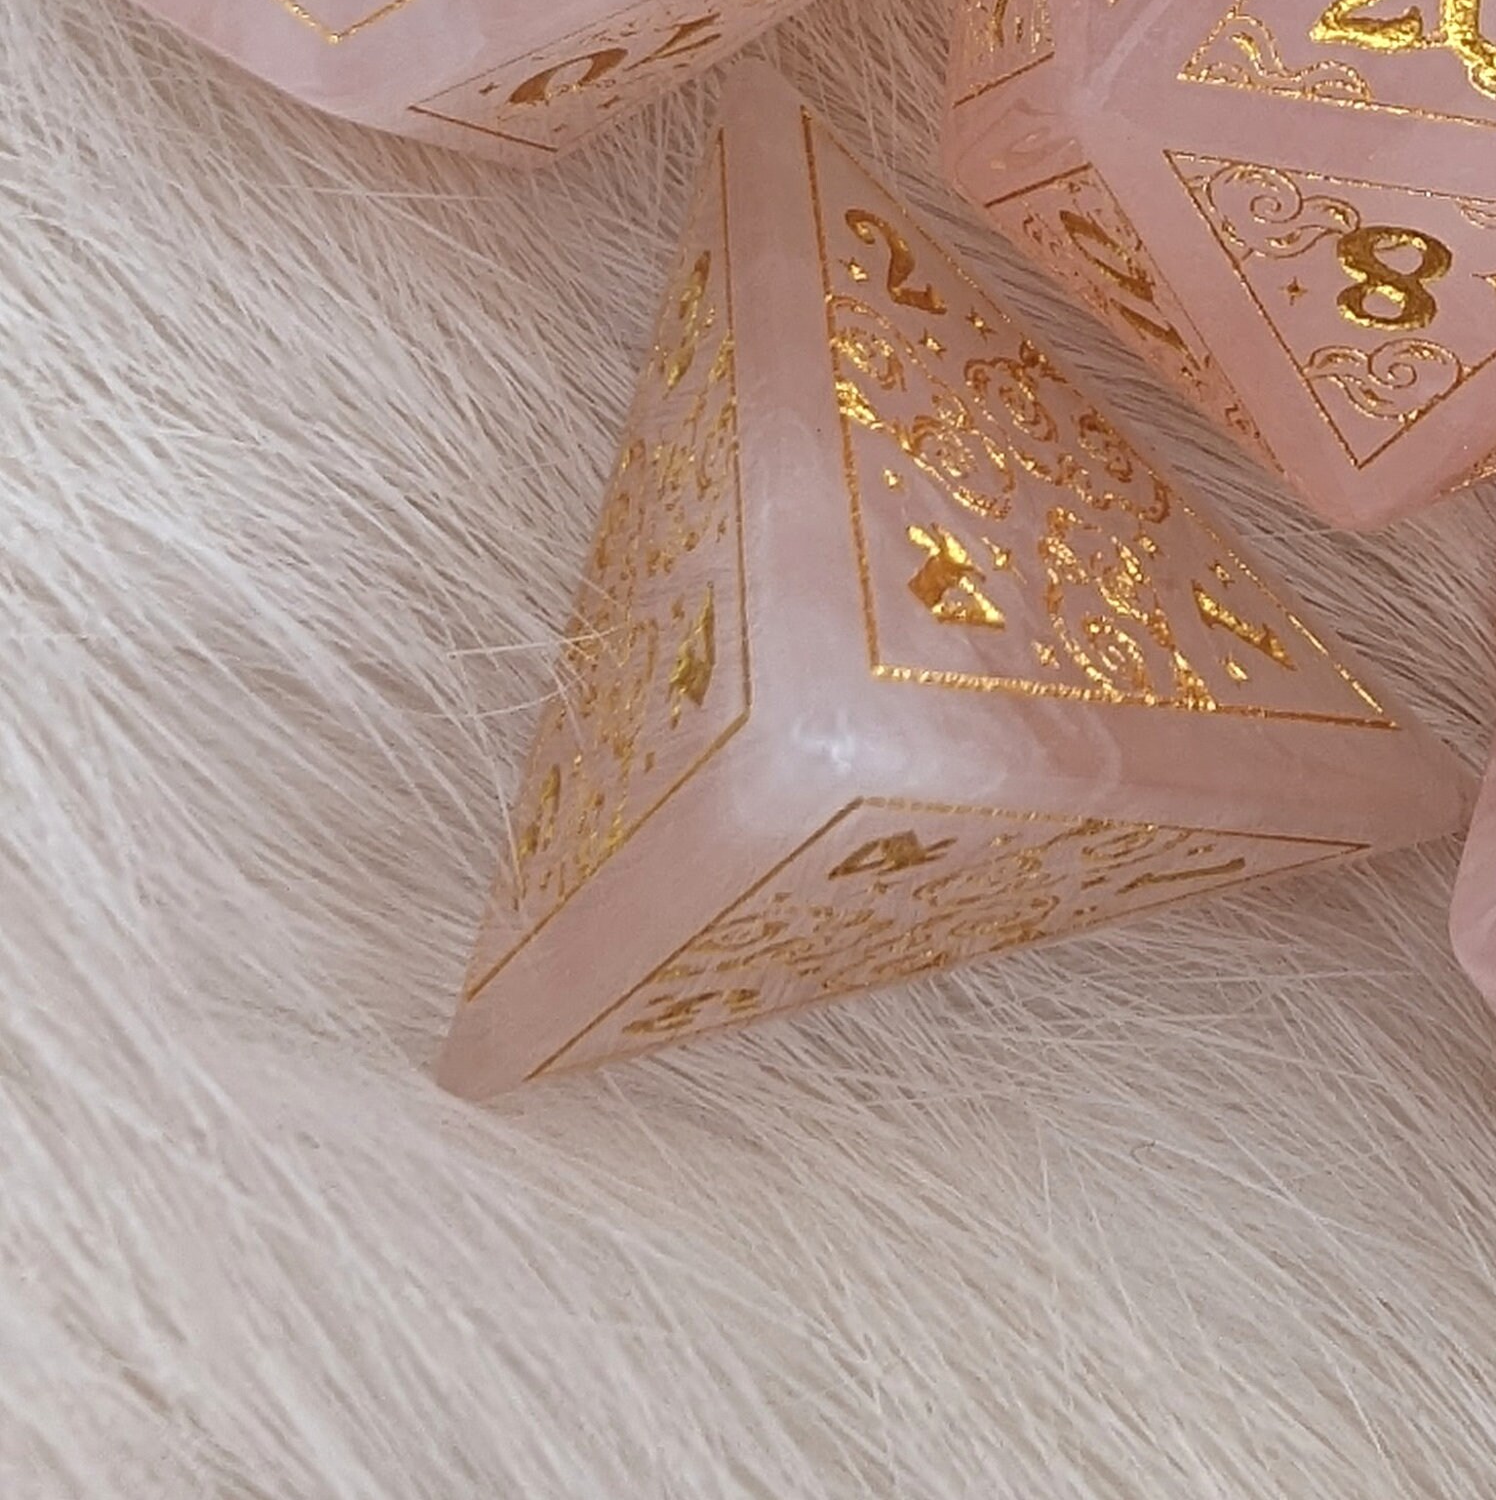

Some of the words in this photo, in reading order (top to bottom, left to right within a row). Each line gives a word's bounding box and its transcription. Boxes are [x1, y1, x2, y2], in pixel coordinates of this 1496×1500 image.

[845, 208, 947, 315] 2
[1336, 226, 1453, 332] 8
[908, 522, 1006, 630] 4
